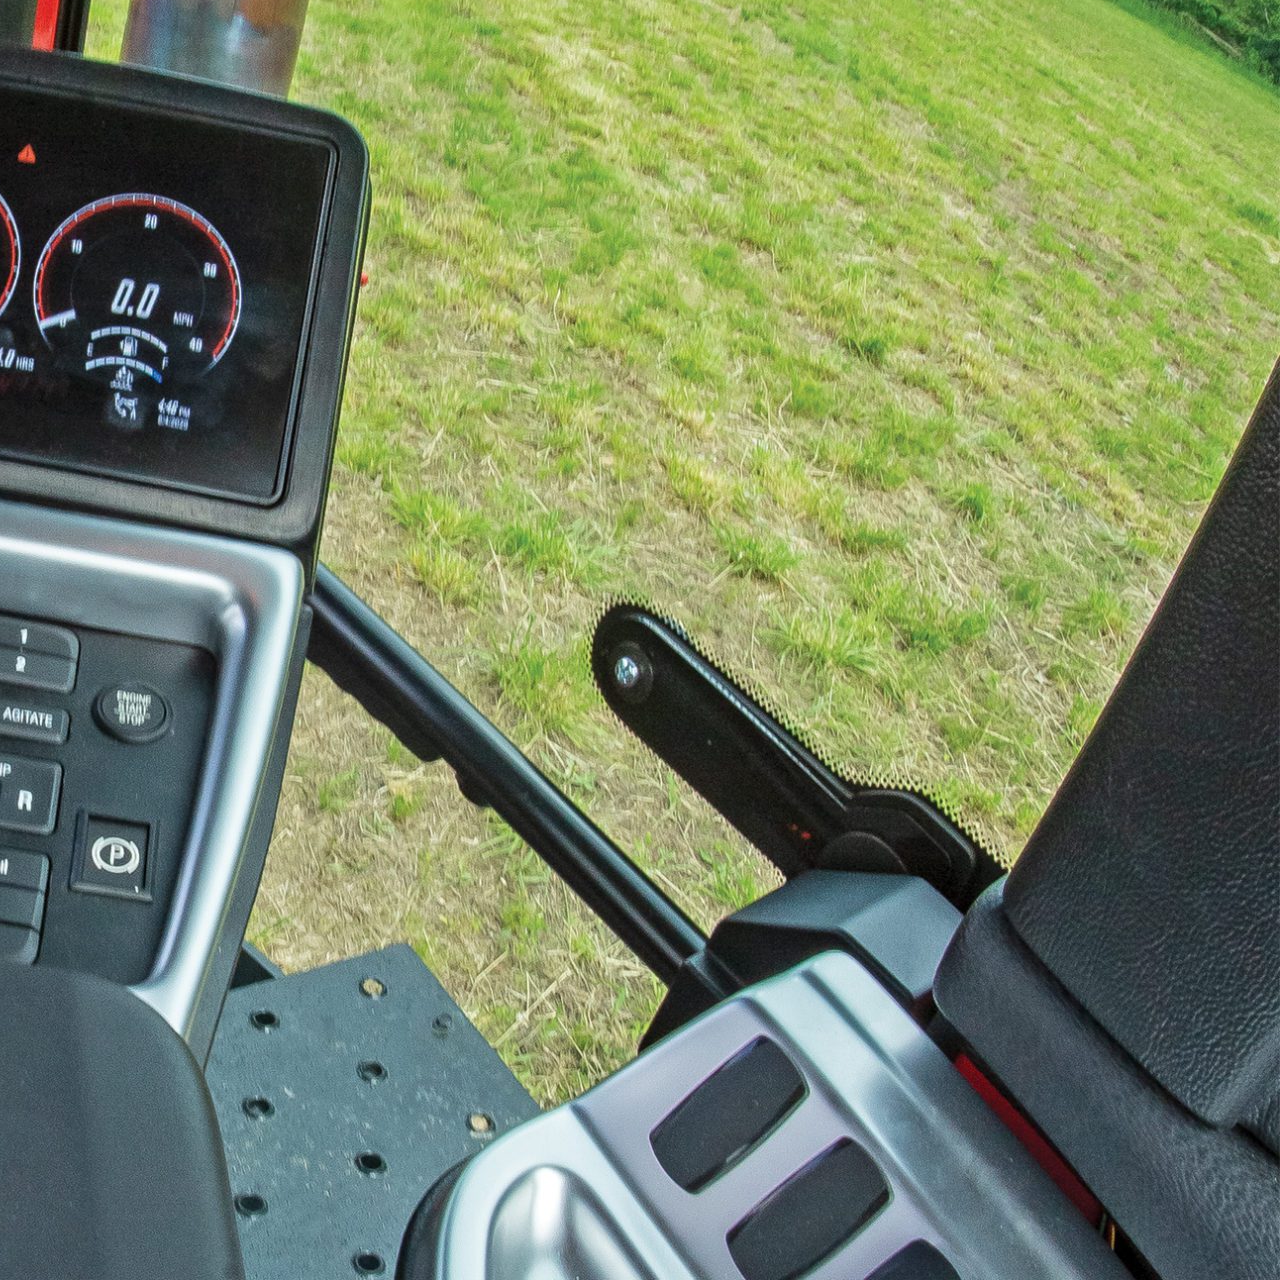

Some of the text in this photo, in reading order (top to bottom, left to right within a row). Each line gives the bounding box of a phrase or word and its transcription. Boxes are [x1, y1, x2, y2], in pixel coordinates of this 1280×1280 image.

[144, 213, 158, 230] 20
[72, 238, 83, 255] 10
[110, 277, 161, 320] 0.0
[173, 311, 194, 328] MPH
[189, 337, 203, 354] 40
[116, 689, 151, 707] ENGINE
[118, 700, 147, 716] START
[2, 705, 53, 729] AGITATE
[118, 713, 145, 727] STOP
[17, 789, 33, 812] R
[109, 843, 125, 866] P
